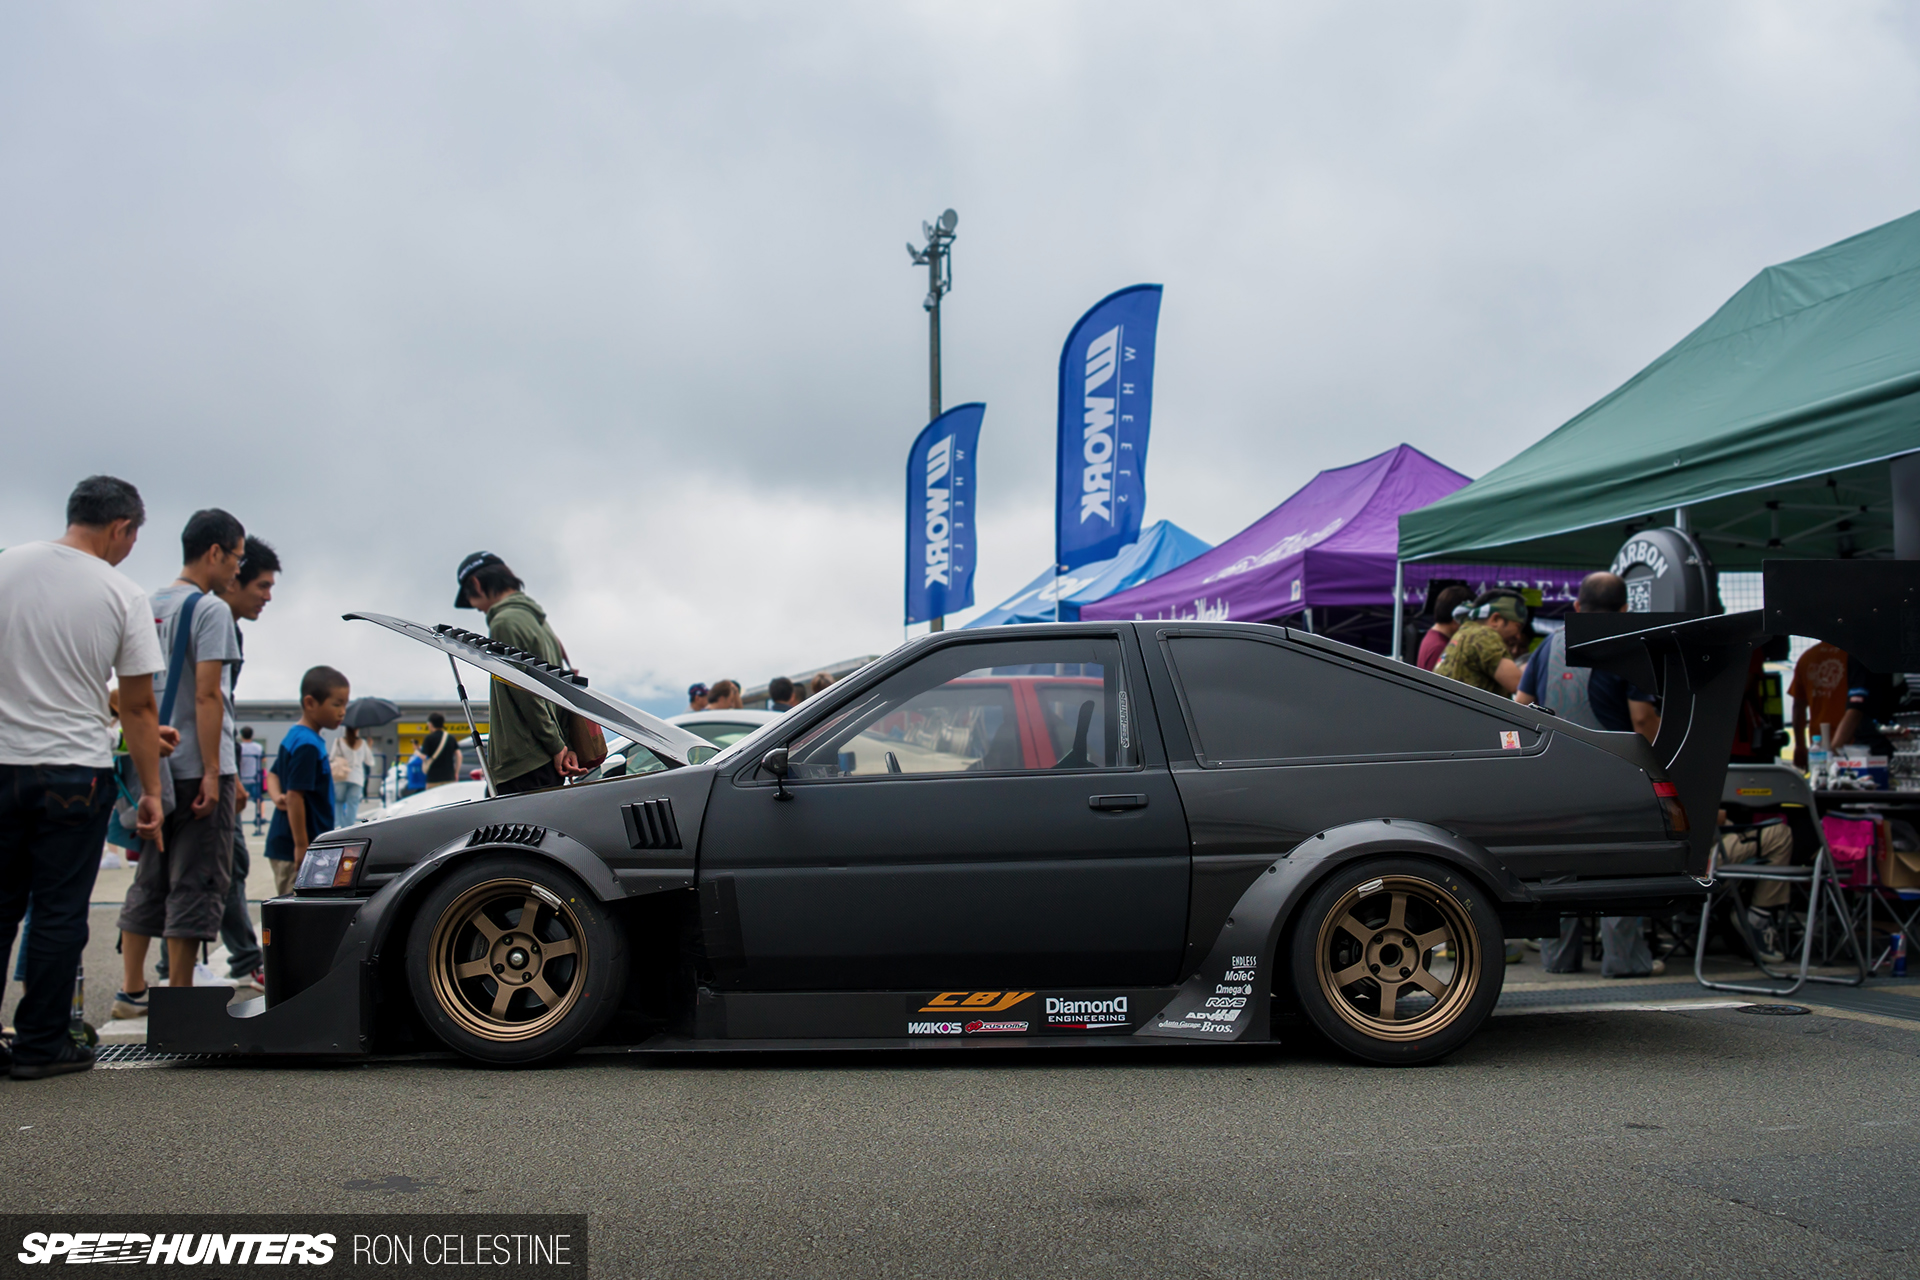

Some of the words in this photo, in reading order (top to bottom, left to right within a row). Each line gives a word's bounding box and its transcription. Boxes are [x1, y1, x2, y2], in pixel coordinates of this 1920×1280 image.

[1231, 955, 1257, 967] ENDLESS
[1224, 970, 1255, 981] MoTeC
[1205, 997, 1247, 1008] RAYS
[1048, 1014, 1126, 1023] ENGINEERING
[1200, 1021, 1233, 1033] Bros.
